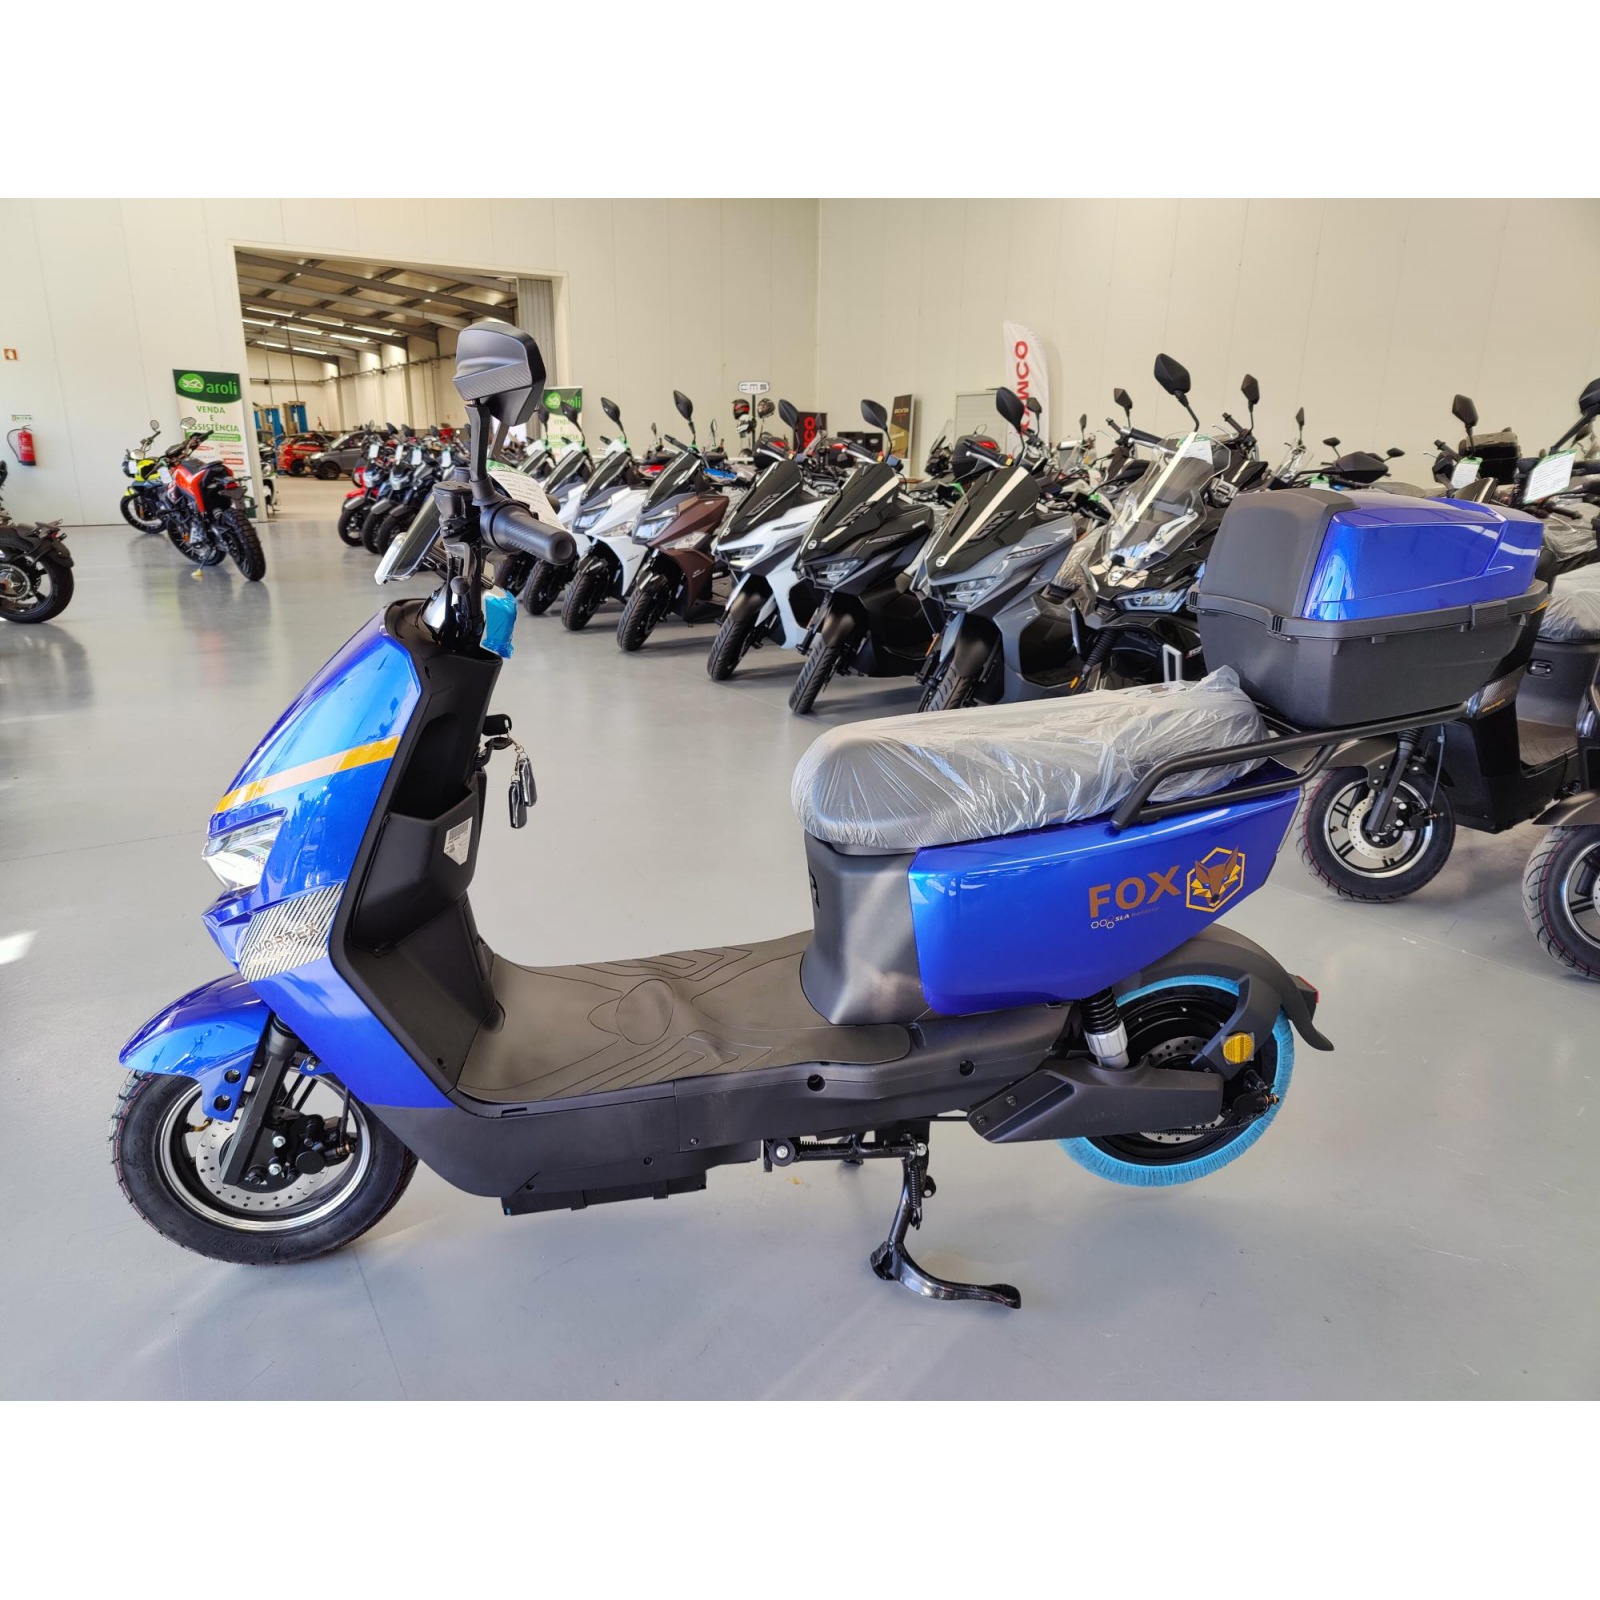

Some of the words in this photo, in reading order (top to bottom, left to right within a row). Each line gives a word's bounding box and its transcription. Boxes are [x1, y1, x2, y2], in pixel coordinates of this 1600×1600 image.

[206, 381, 238, 395] aroli
[196, 405, 225, 414] VENDA
[1089, 864, 1182, 918] FOX
[1115, 913, 1130, 922] SLA
[254, 922, 320, 954] VORTEX
